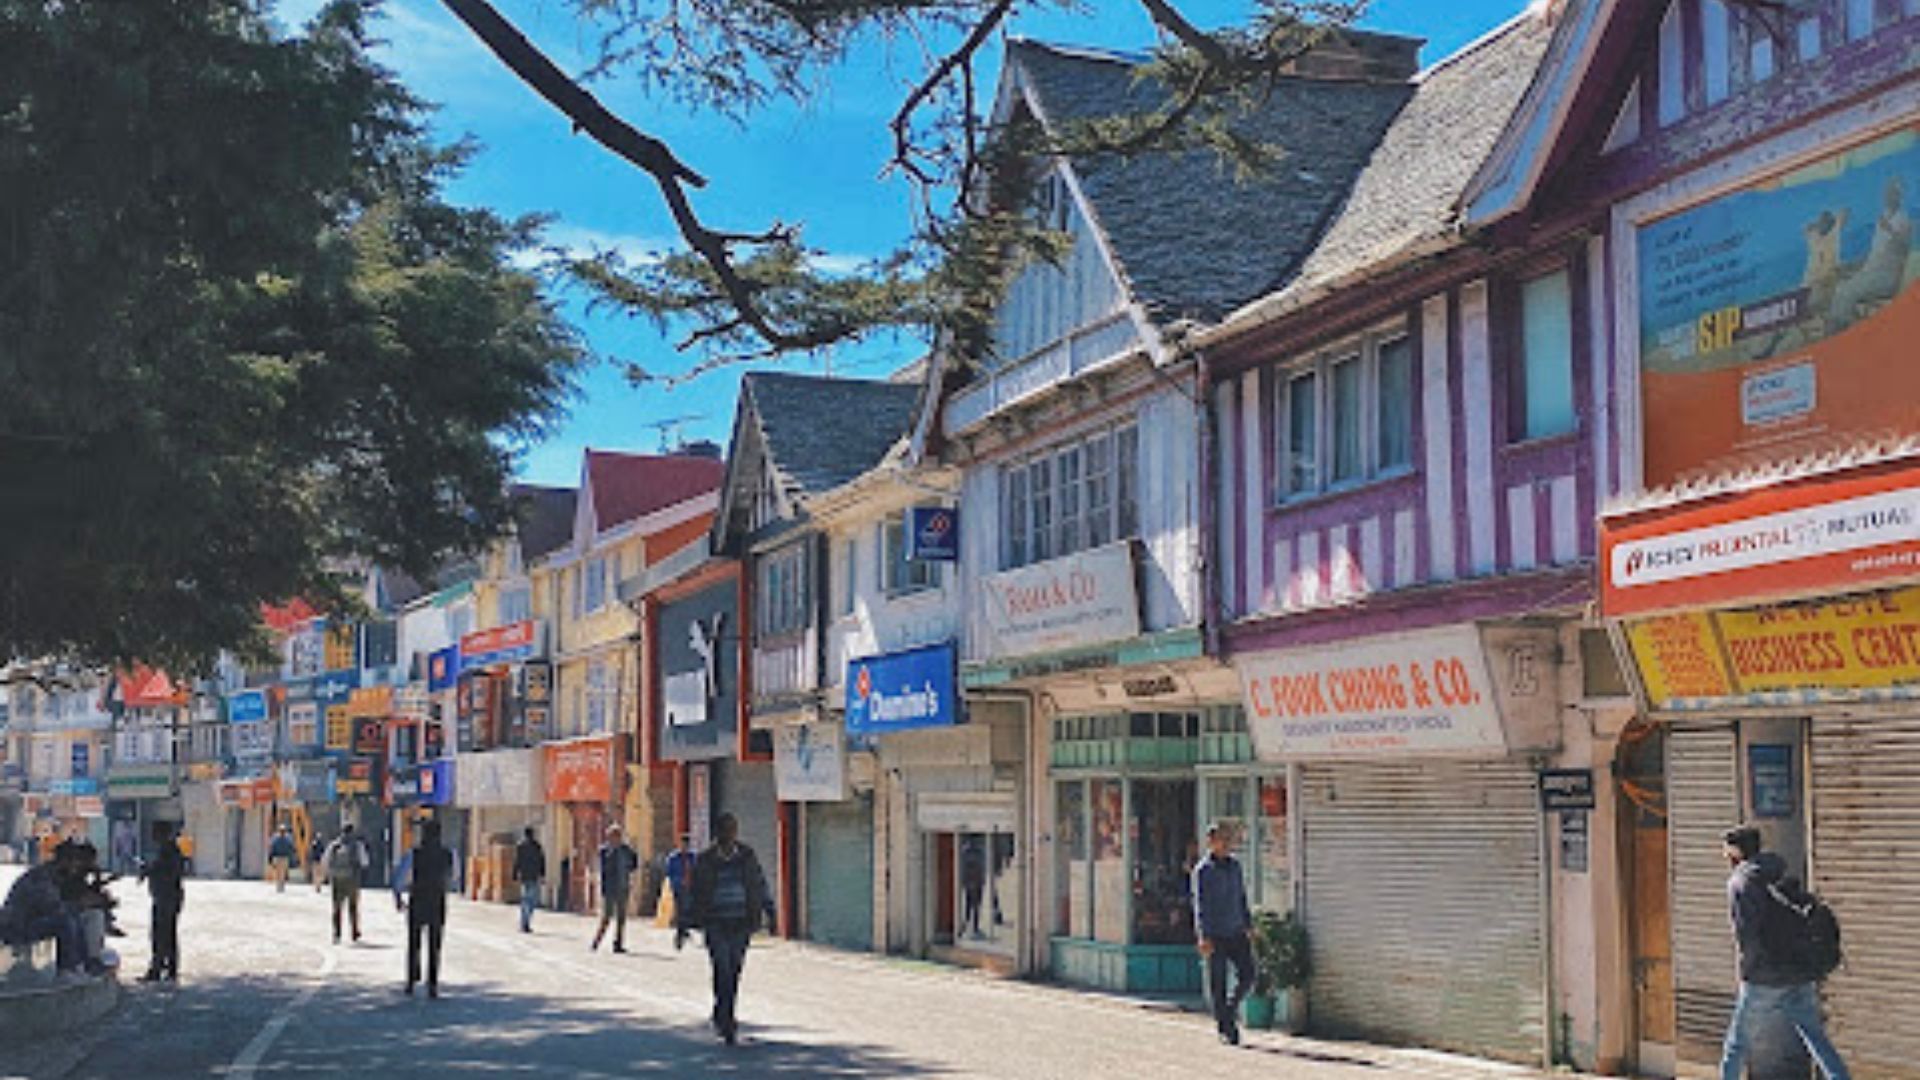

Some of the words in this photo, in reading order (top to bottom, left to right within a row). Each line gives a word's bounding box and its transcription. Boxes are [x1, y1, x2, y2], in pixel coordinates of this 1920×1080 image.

[1699, 306, 1740, 351] SIP
[1730, 629, 1845, 677] BUSINESS
[1270, 671, 1328, 717] FOOK
[1326, 663, 1408, 713] CHONG
[1410, 661, 1433, 709] &
[1434, 656, 1482, 706] CO.
